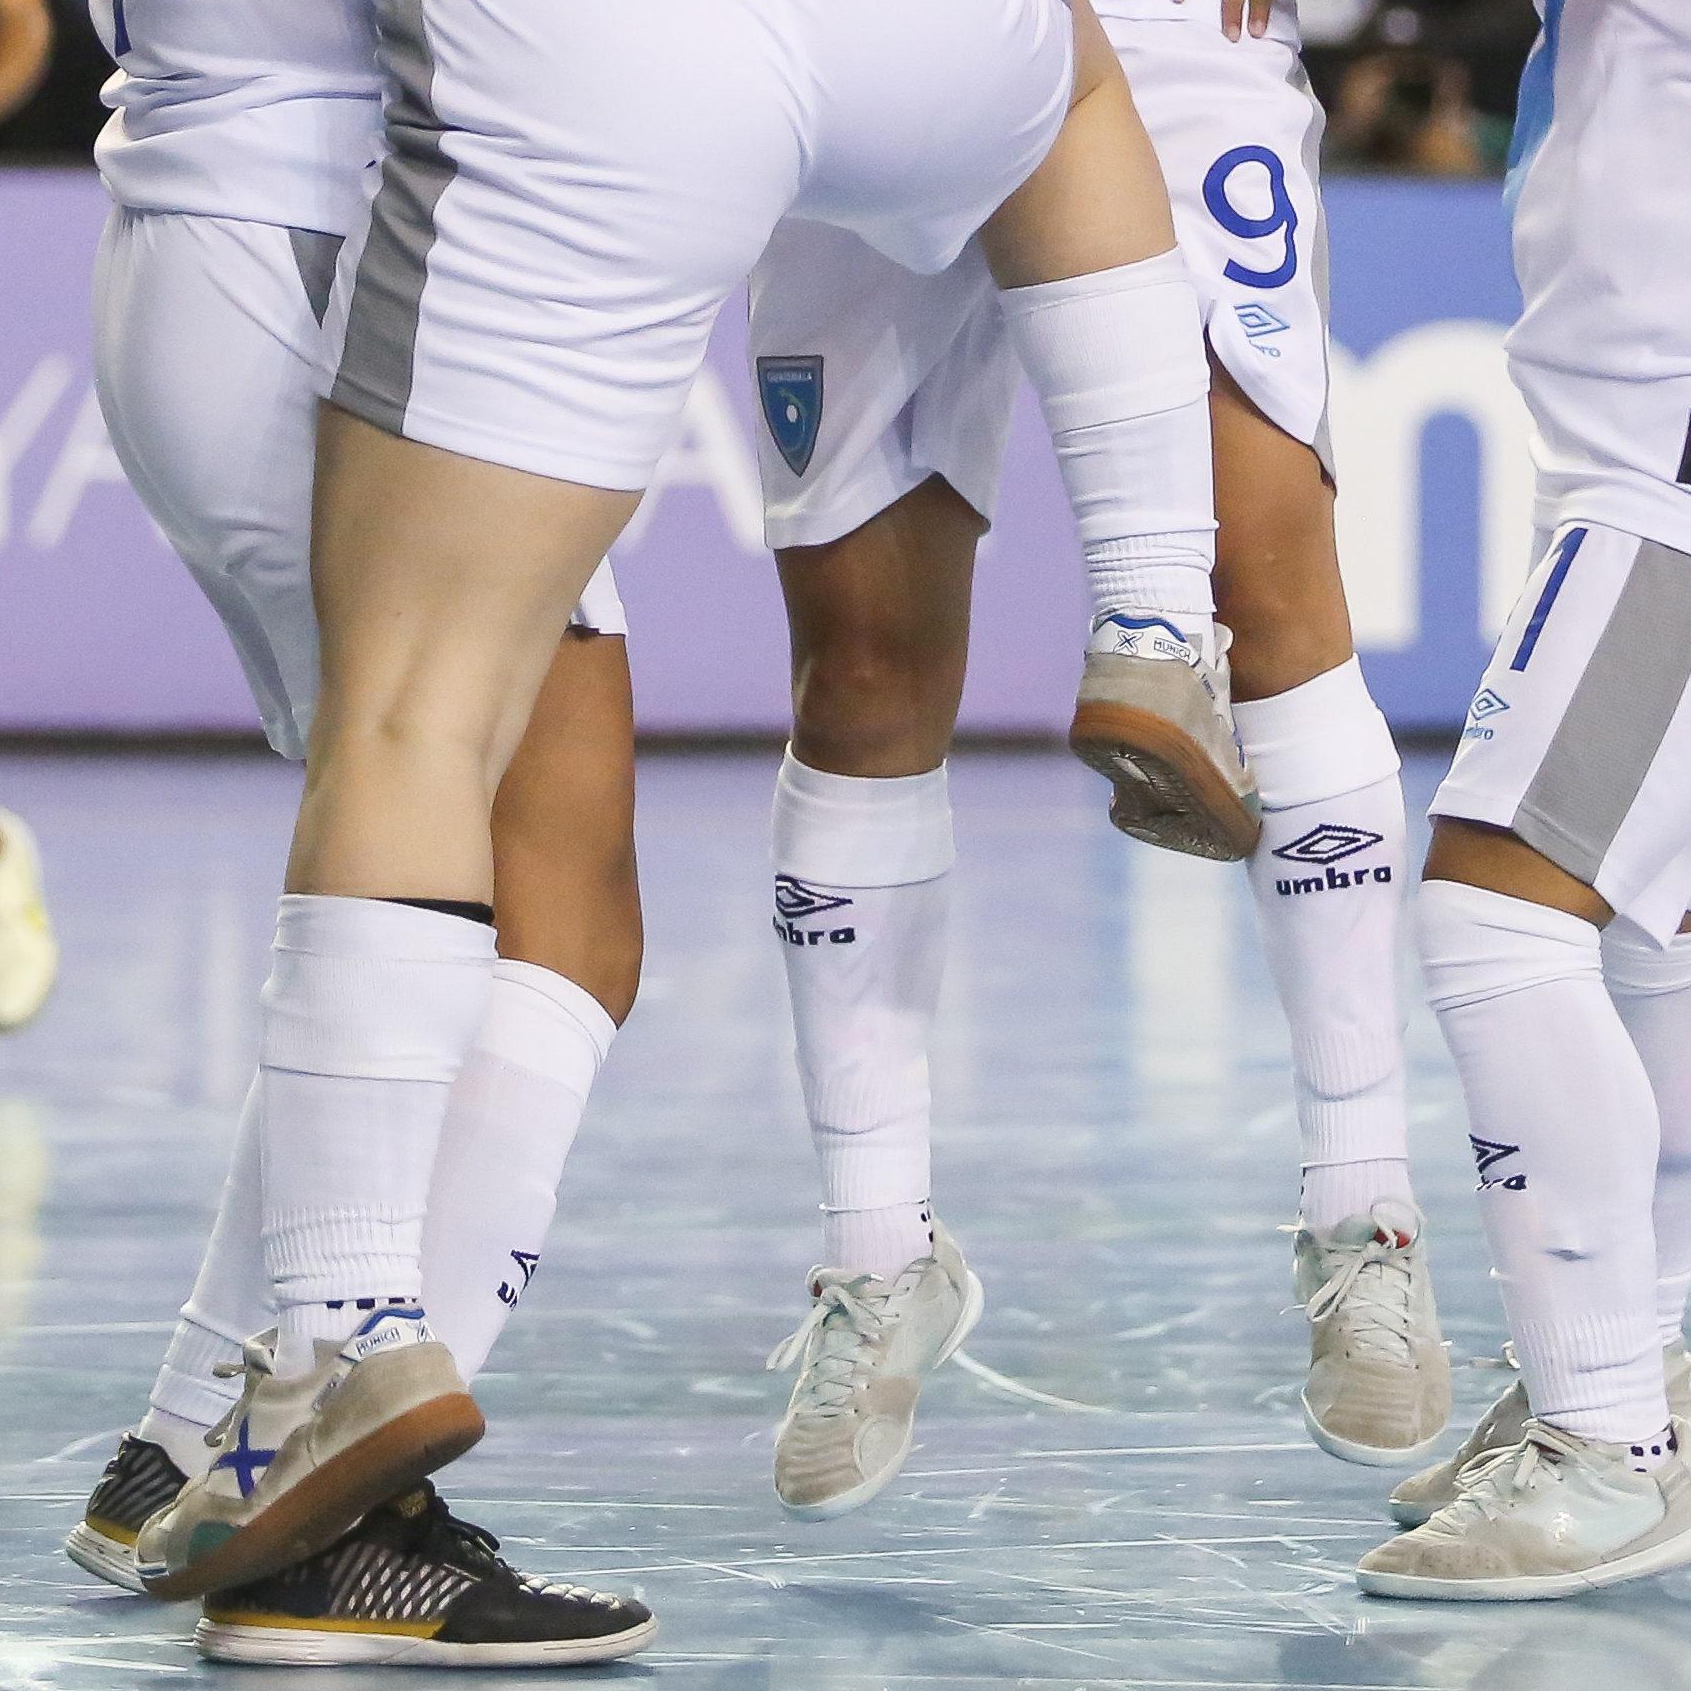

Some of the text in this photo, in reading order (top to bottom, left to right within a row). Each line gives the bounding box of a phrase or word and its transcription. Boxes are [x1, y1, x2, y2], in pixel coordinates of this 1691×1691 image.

[1202, 145, 1298, 289] 9
[1155, 640, 1191, 658] MUNICH
[1276, 867, 1392, 896] umbro
